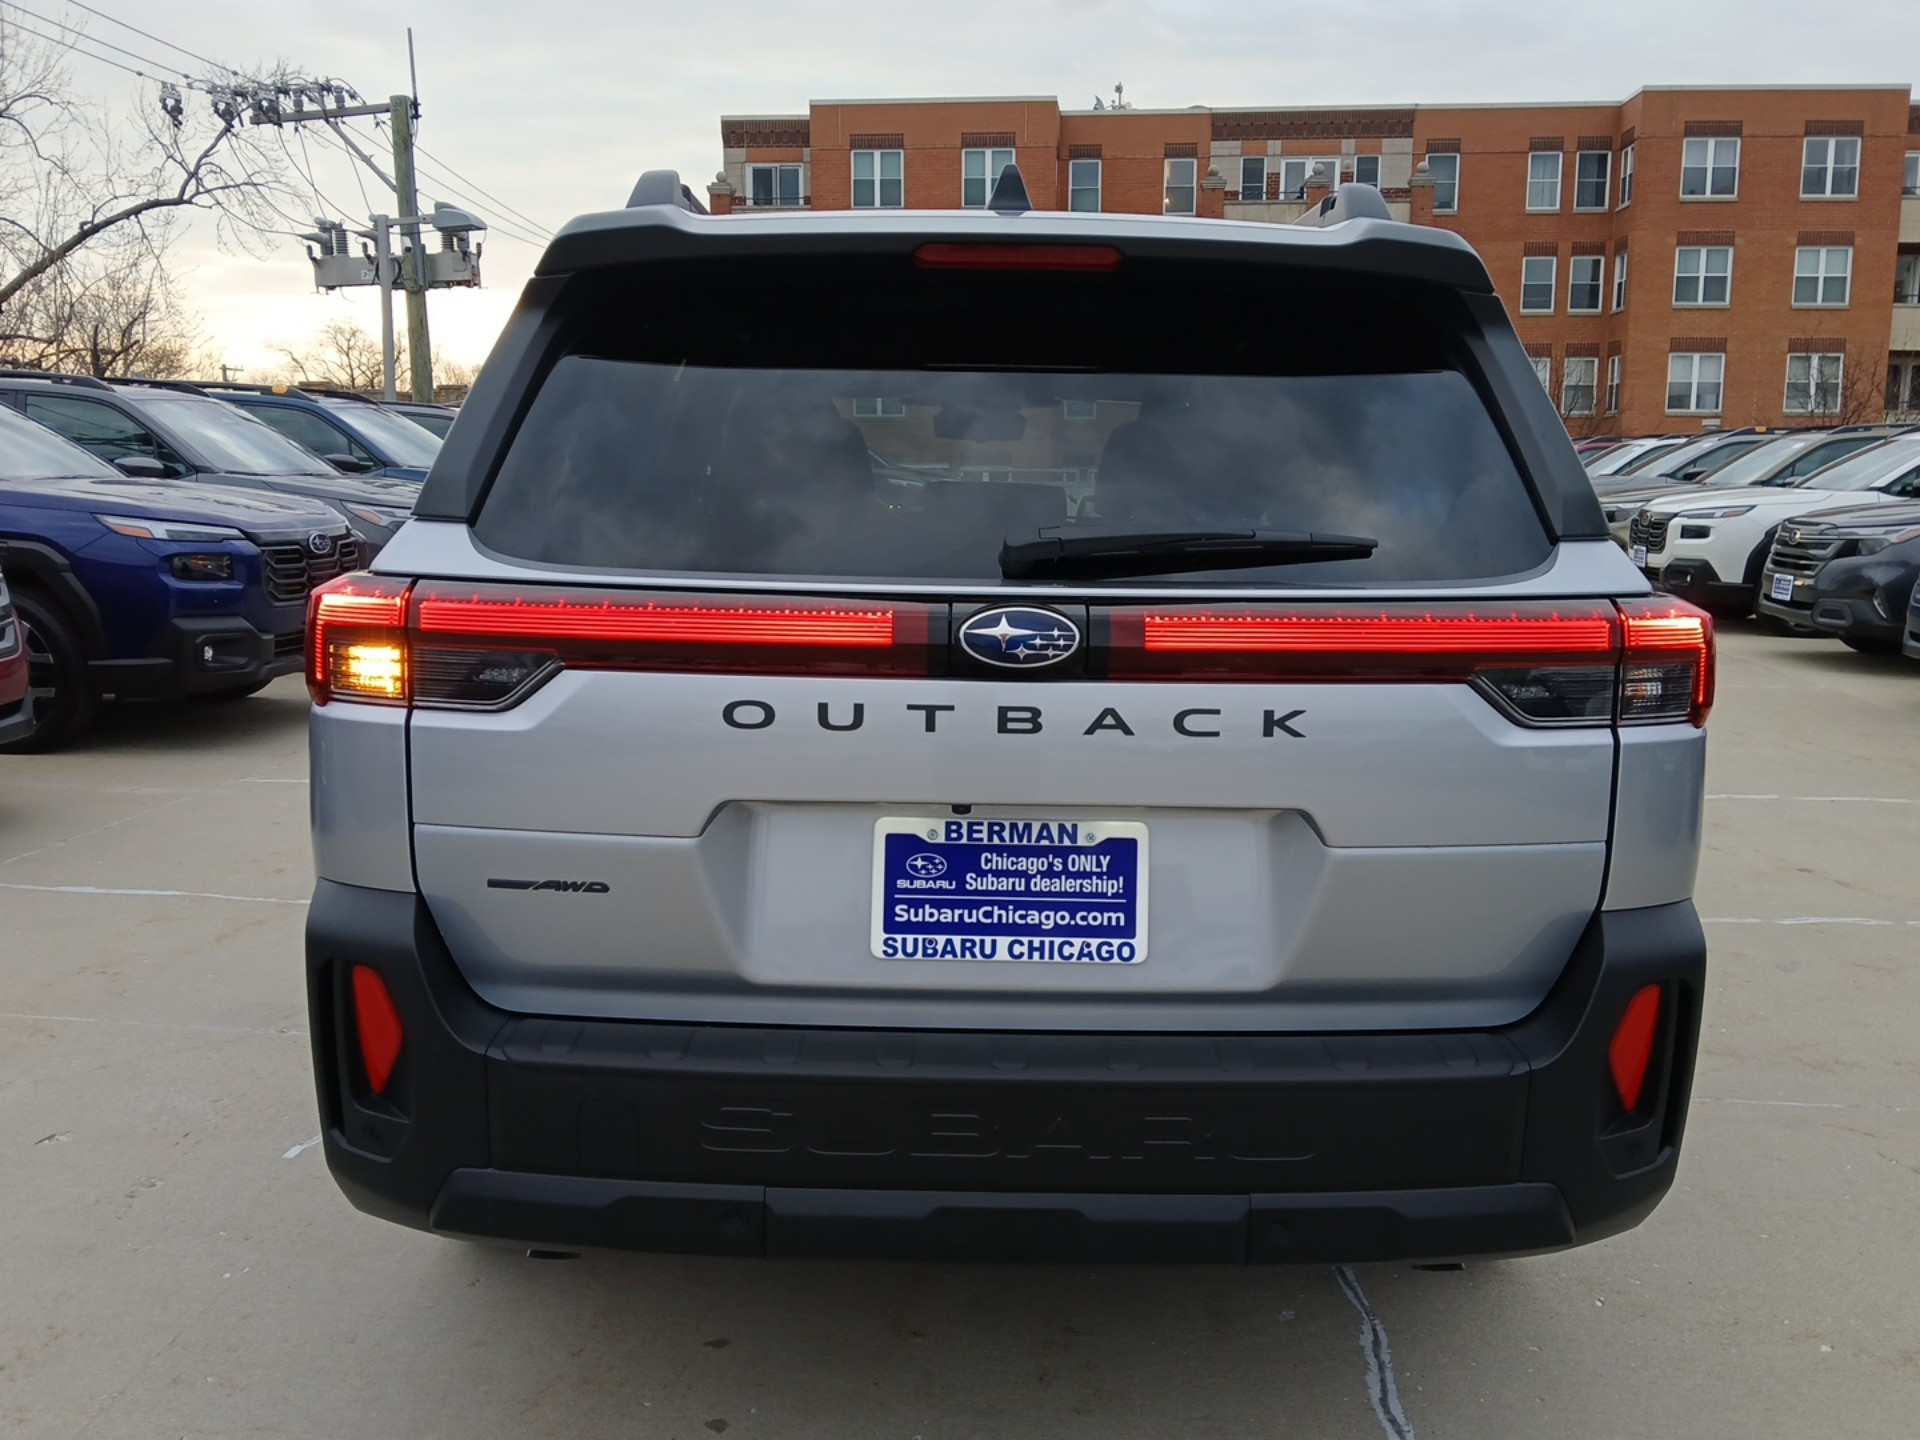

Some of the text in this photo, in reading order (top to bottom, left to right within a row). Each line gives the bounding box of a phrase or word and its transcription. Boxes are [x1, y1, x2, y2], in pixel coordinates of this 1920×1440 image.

[721, 699, 1308, 738] OUTBACK
[943, 820, 1079, 845] BERMAN
[980, 852, 1111, 874] Chicago's ONLY
[532, 879, 610, 894] AWD
[896, 879, 956, 890] SUBARU
[965, 873, 1124, 897] Subaru dealership!
[893, 904, 1126, 930] SubaruChicago.com
[882, 937, 1136, 963] SUBARU CHICAGO
